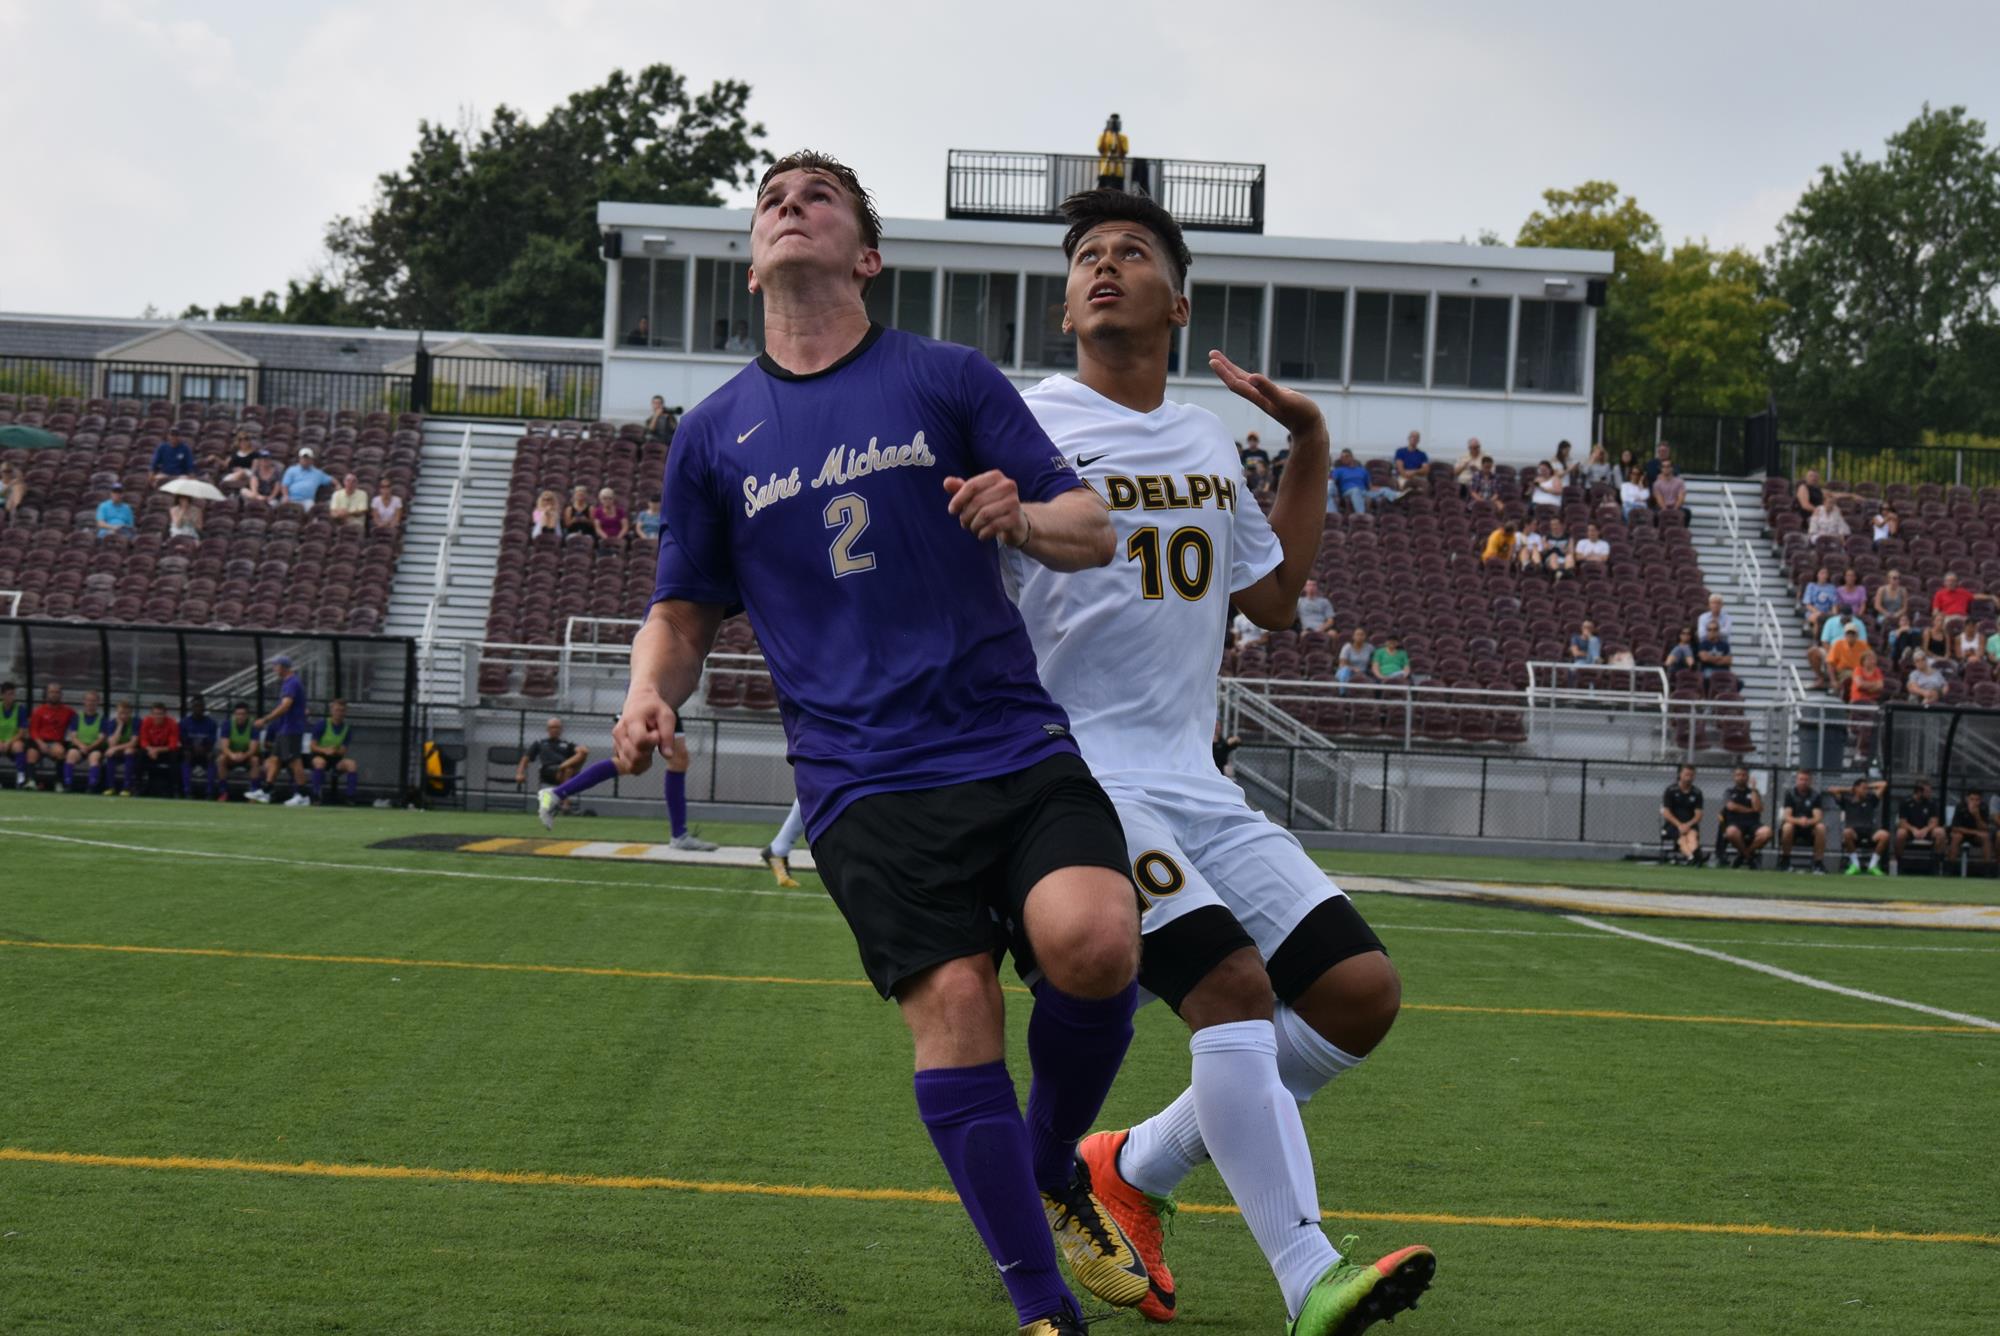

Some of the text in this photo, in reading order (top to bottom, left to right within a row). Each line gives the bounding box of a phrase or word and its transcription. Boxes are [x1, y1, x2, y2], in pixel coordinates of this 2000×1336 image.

[743, 430, 936, 519] Saint Michaels
[1082, 473, 1238, 516] DELPH
[822, 491, 877, 579] 2
[1127, 525, 1214, 602] 10
[1133, 849, 1186, 912] 0
